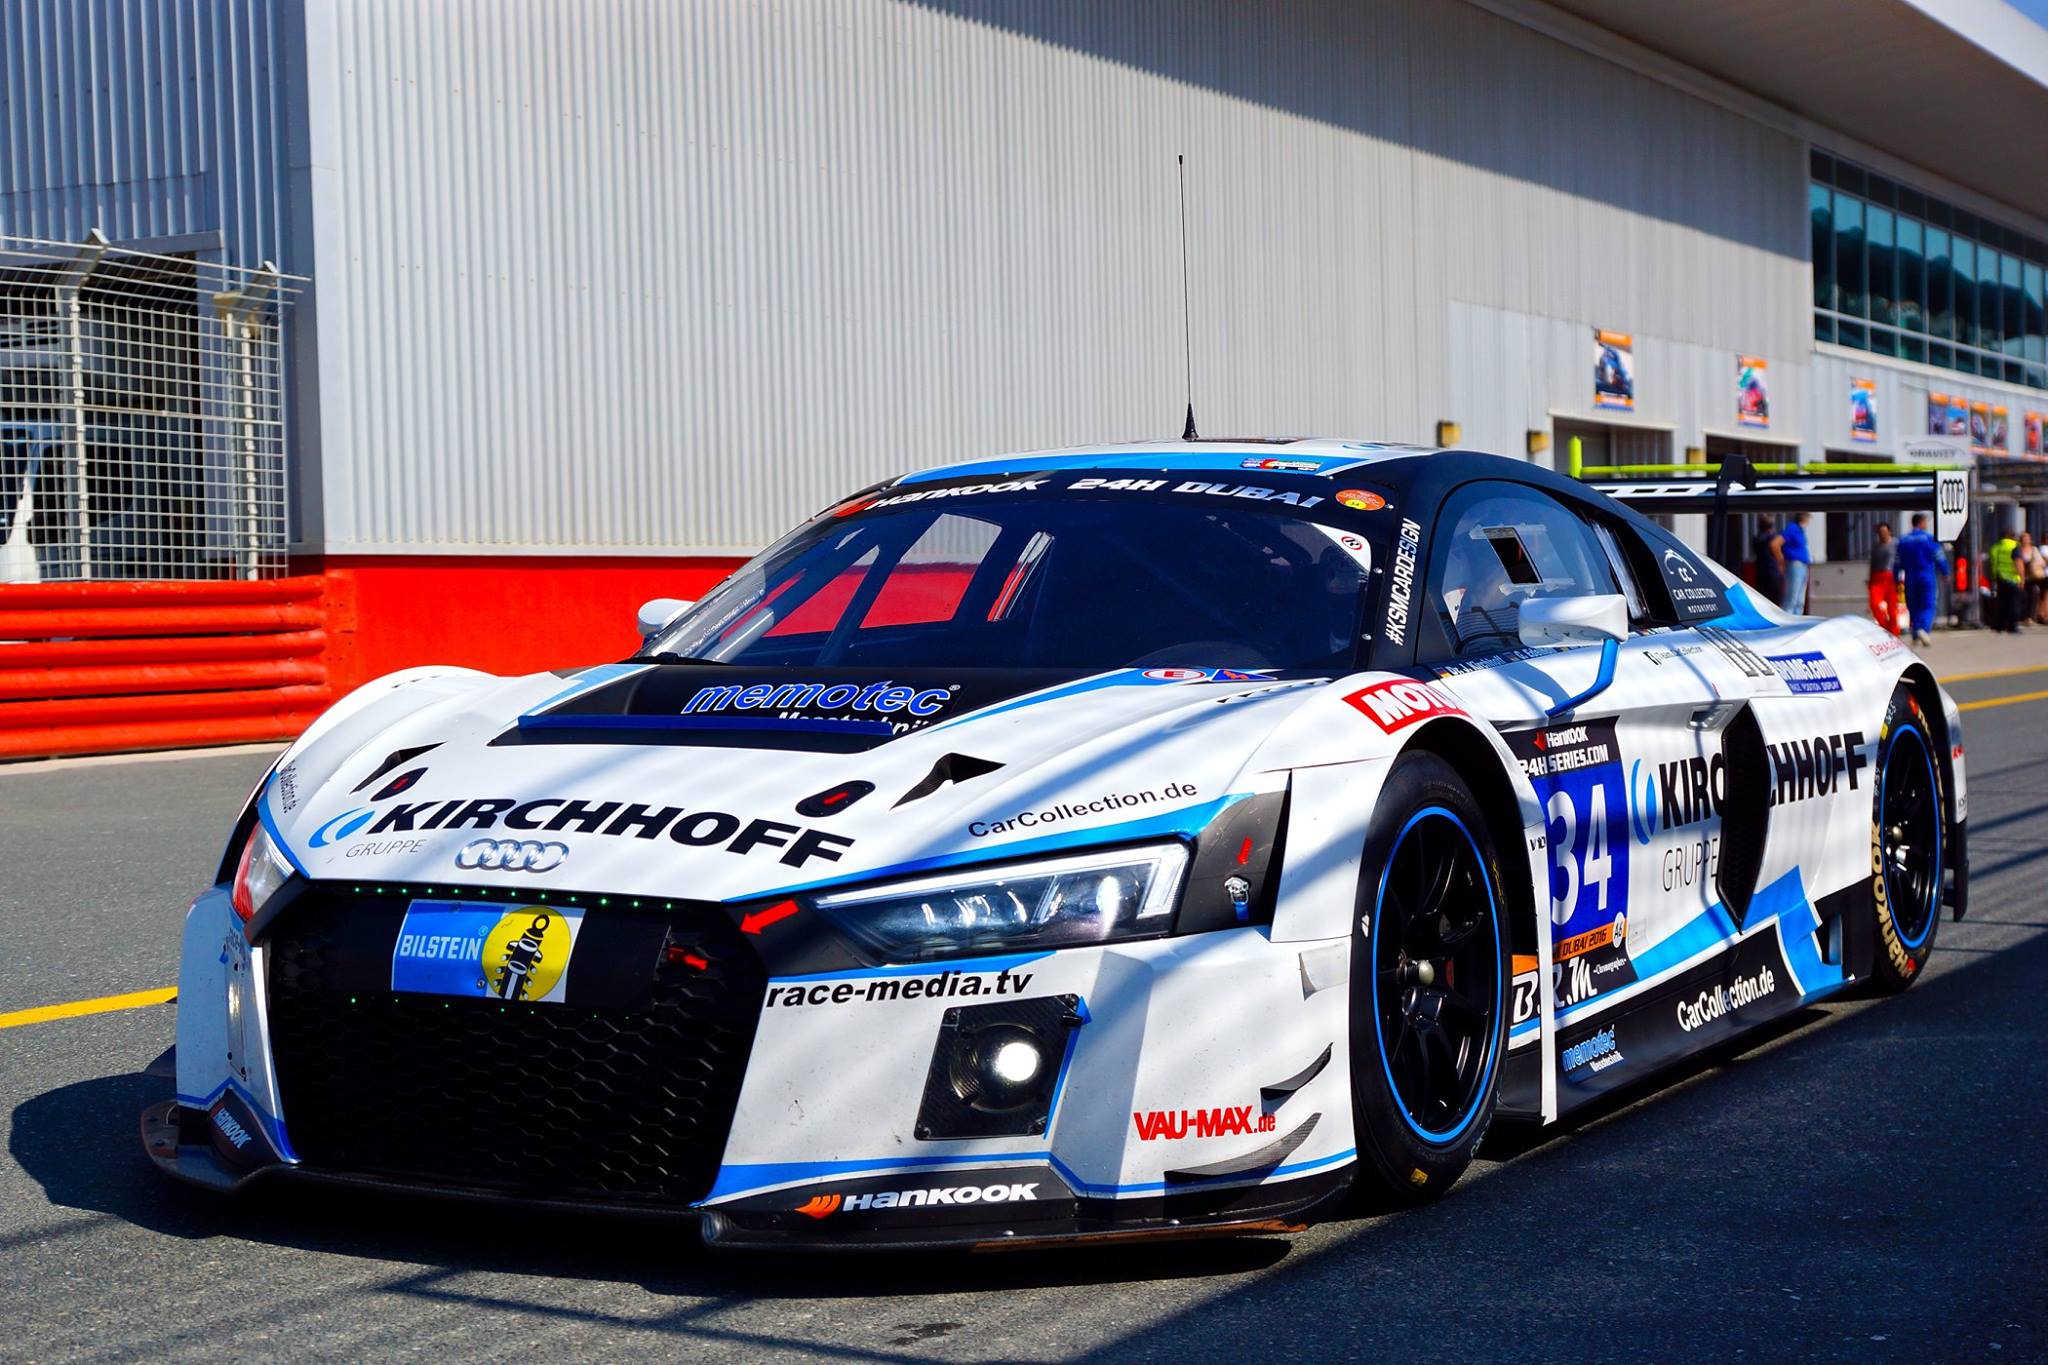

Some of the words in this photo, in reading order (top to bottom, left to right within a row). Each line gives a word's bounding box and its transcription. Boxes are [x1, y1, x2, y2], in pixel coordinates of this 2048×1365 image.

[1067, 478, 1169, 491] 24H
[1172, 481, 1326, 508] DUBAI
[1385, 517, 1421, 646] #KSMCARDESIGN
[678, 680, 951, 716] memotec
[1519, 756, 1549, 779] 24H
[1549, 744, 1609, 773] SERIES.COM
[968, 782, 1198, 838] CarCollection.de
[345, 838, 427, 859] GRUPPE
[366, 798, 857, 869] KIRCHHOFF
[1547, 784, 1612, 926] 34
[1662, 838, 1719, 892] GRUPPE
[400, 934, 482, 961] BILSTEIN
[1588, 928, 1608, 951] 2016
[766, 970, 1034, 1008] race-media.tv
[1677, 965, 1775, 1032] CarCollection.de
[1562, 1029, 1616, 1072] memotec
[1133, 1104, 1276, 1141] VAU-MAX.de
